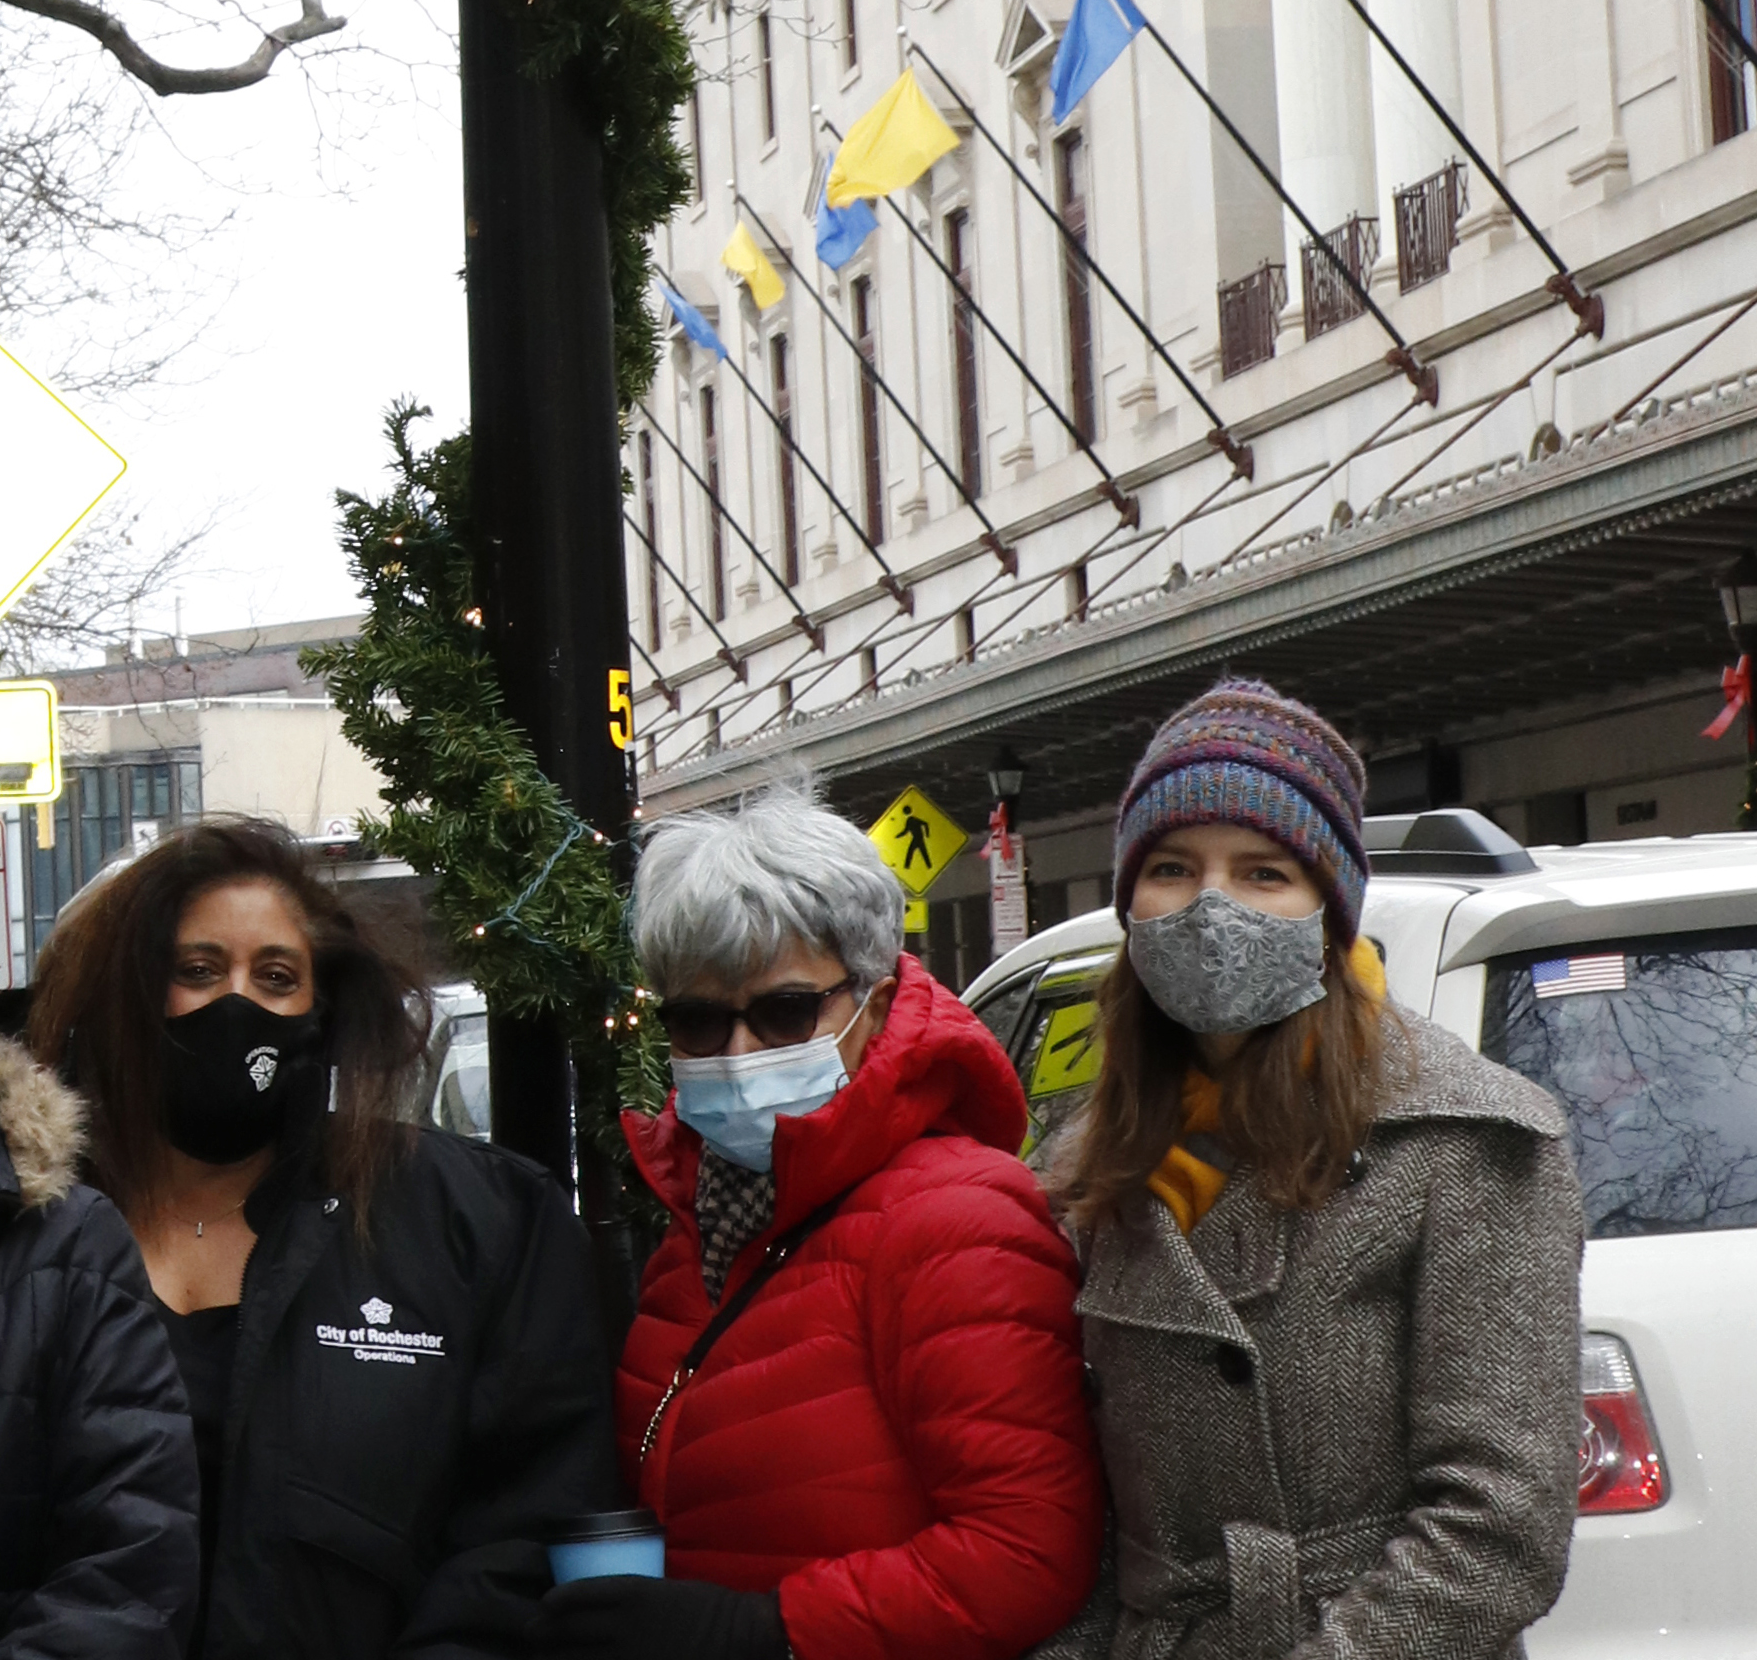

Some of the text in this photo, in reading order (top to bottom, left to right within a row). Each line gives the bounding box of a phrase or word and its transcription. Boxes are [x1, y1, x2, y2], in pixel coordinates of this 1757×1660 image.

[608, 669, 633, 750] 5
[316, 1324, 444, 1348] City of Rochester
[353, 1349, 416, 1364] Operations
